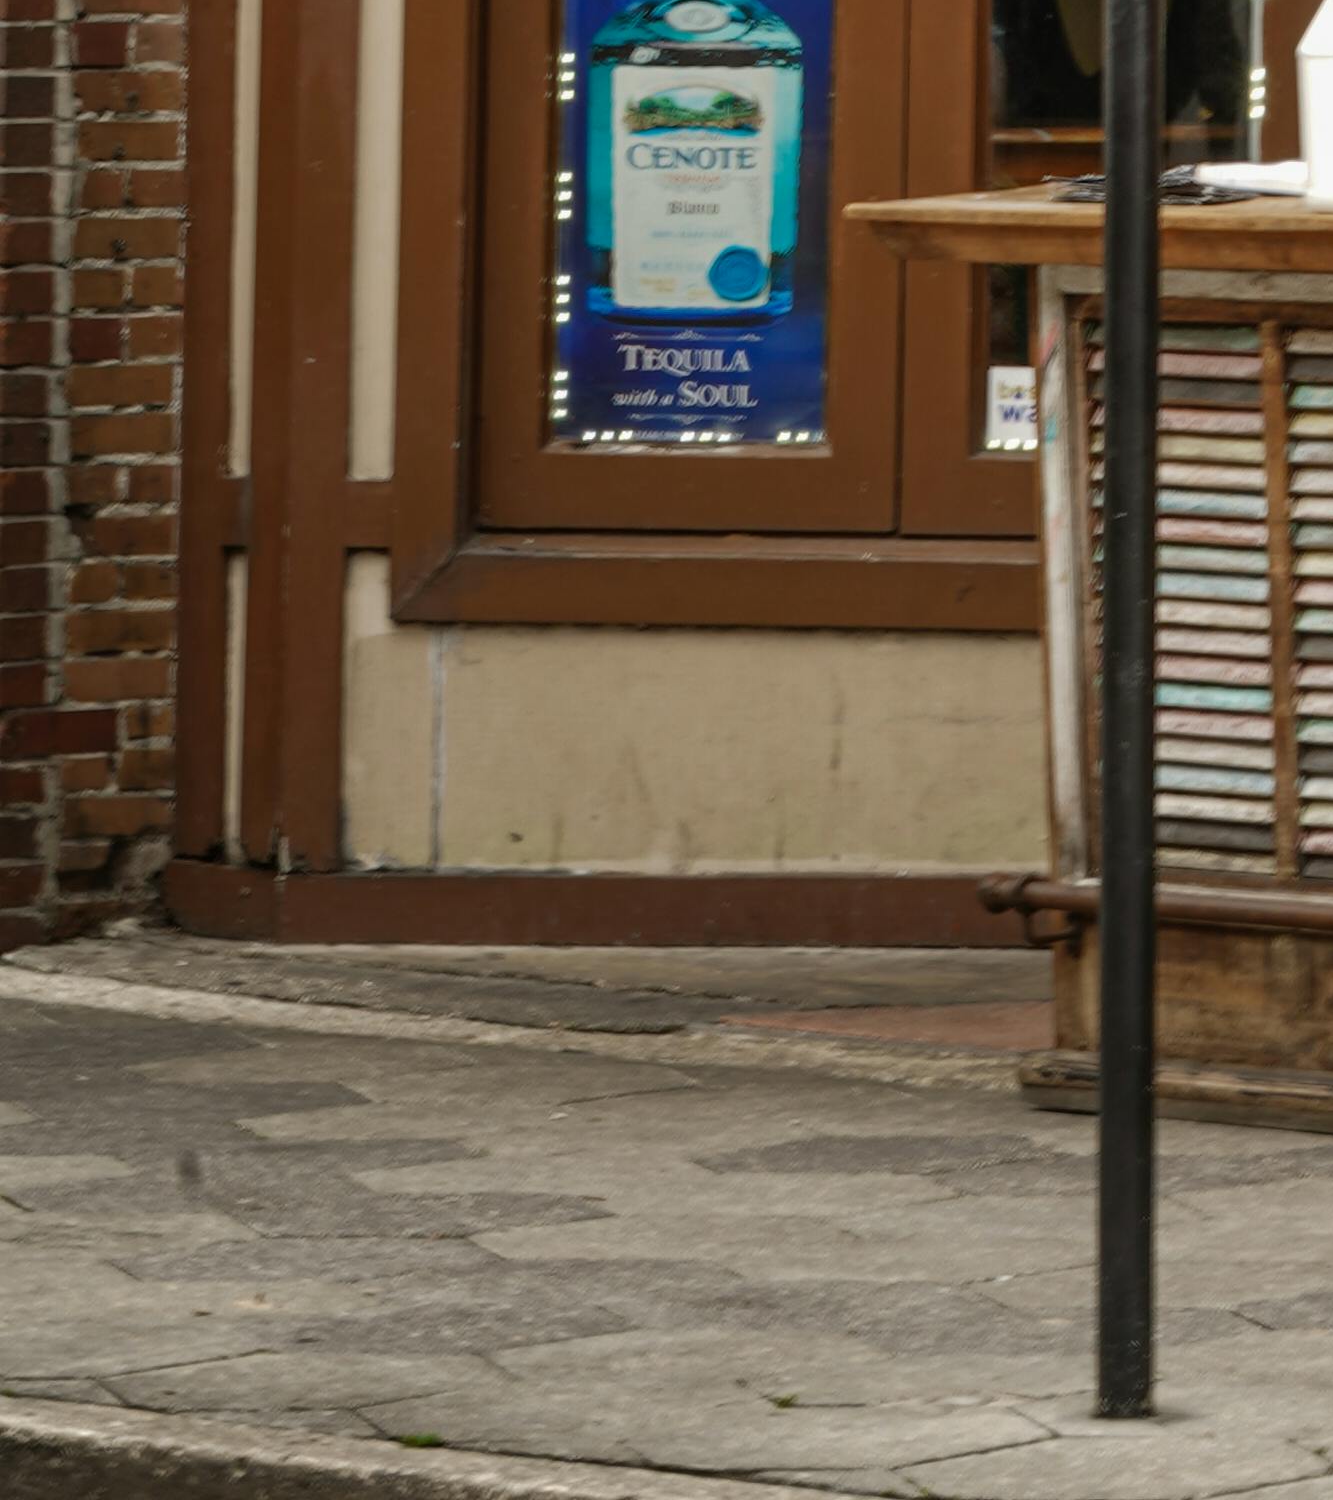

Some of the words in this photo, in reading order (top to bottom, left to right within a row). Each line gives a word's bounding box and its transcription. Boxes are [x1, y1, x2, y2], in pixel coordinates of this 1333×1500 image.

[626, 141, 759, 171] CENOTE
[616, 343, 752, 377] TEQUILA
[677, 380, 759, 408] SOUL
